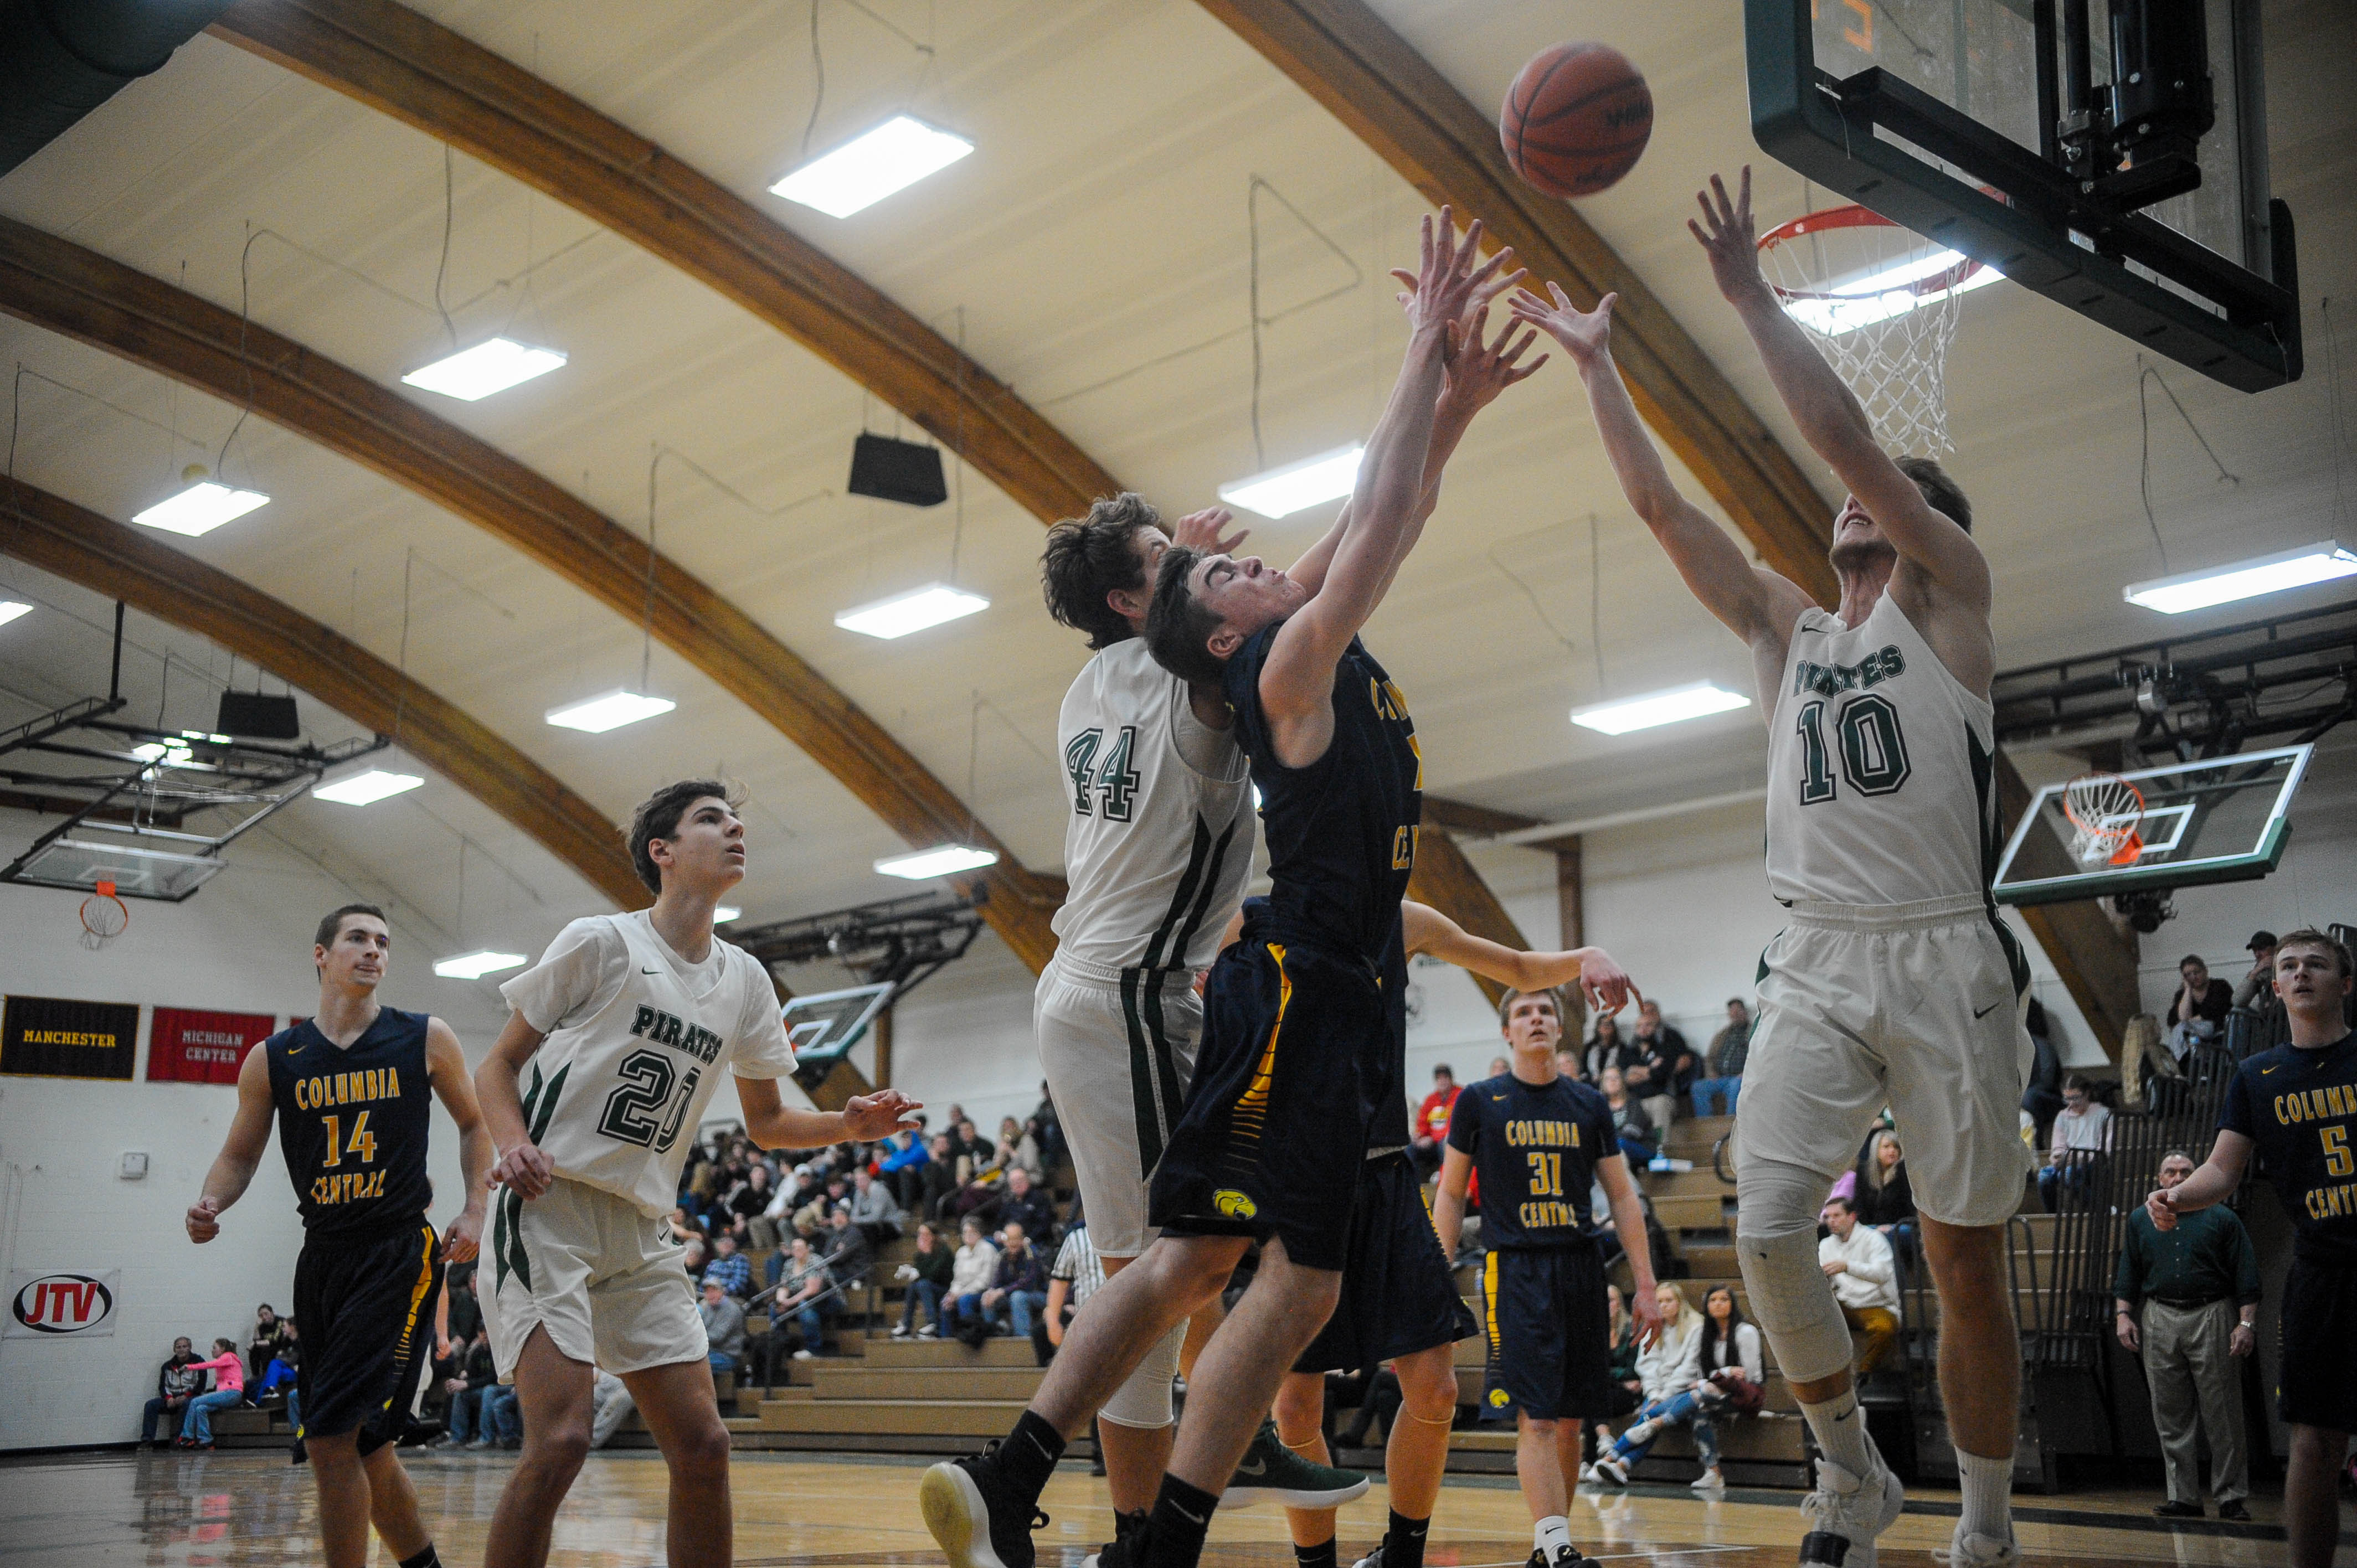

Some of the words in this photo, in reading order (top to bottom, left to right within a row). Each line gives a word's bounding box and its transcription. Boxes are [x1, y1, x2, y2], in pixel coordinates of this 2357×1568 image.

[1797, 693, 1912, 806] 10
[1064, 725, 1141, 823] 44
[23, 1029, 116, 1048] MANCHESTER
[182, 1029, 244, 1048] MICHIGAN
[186, 1046, 236, 1064] CENTER
[629, 1003, 723, 1066] PIRATES
[295, 1067, 400, 1111] COLUMBIA
[596, 1049, 701, 1154] 20
[2274, 1082, 2357, 1125] COLUMB
[322, 1110, 377, 1168] 14
[1505, 1120, 1581, 1148] COLUMBIA
[2319, 1125, 2354, 1176] 5
[311, 1169, 387, 1204] CENTRAL
[1527, 1152, 1563, 1196] 31
[24, 1281, 99, 1325] JTV
